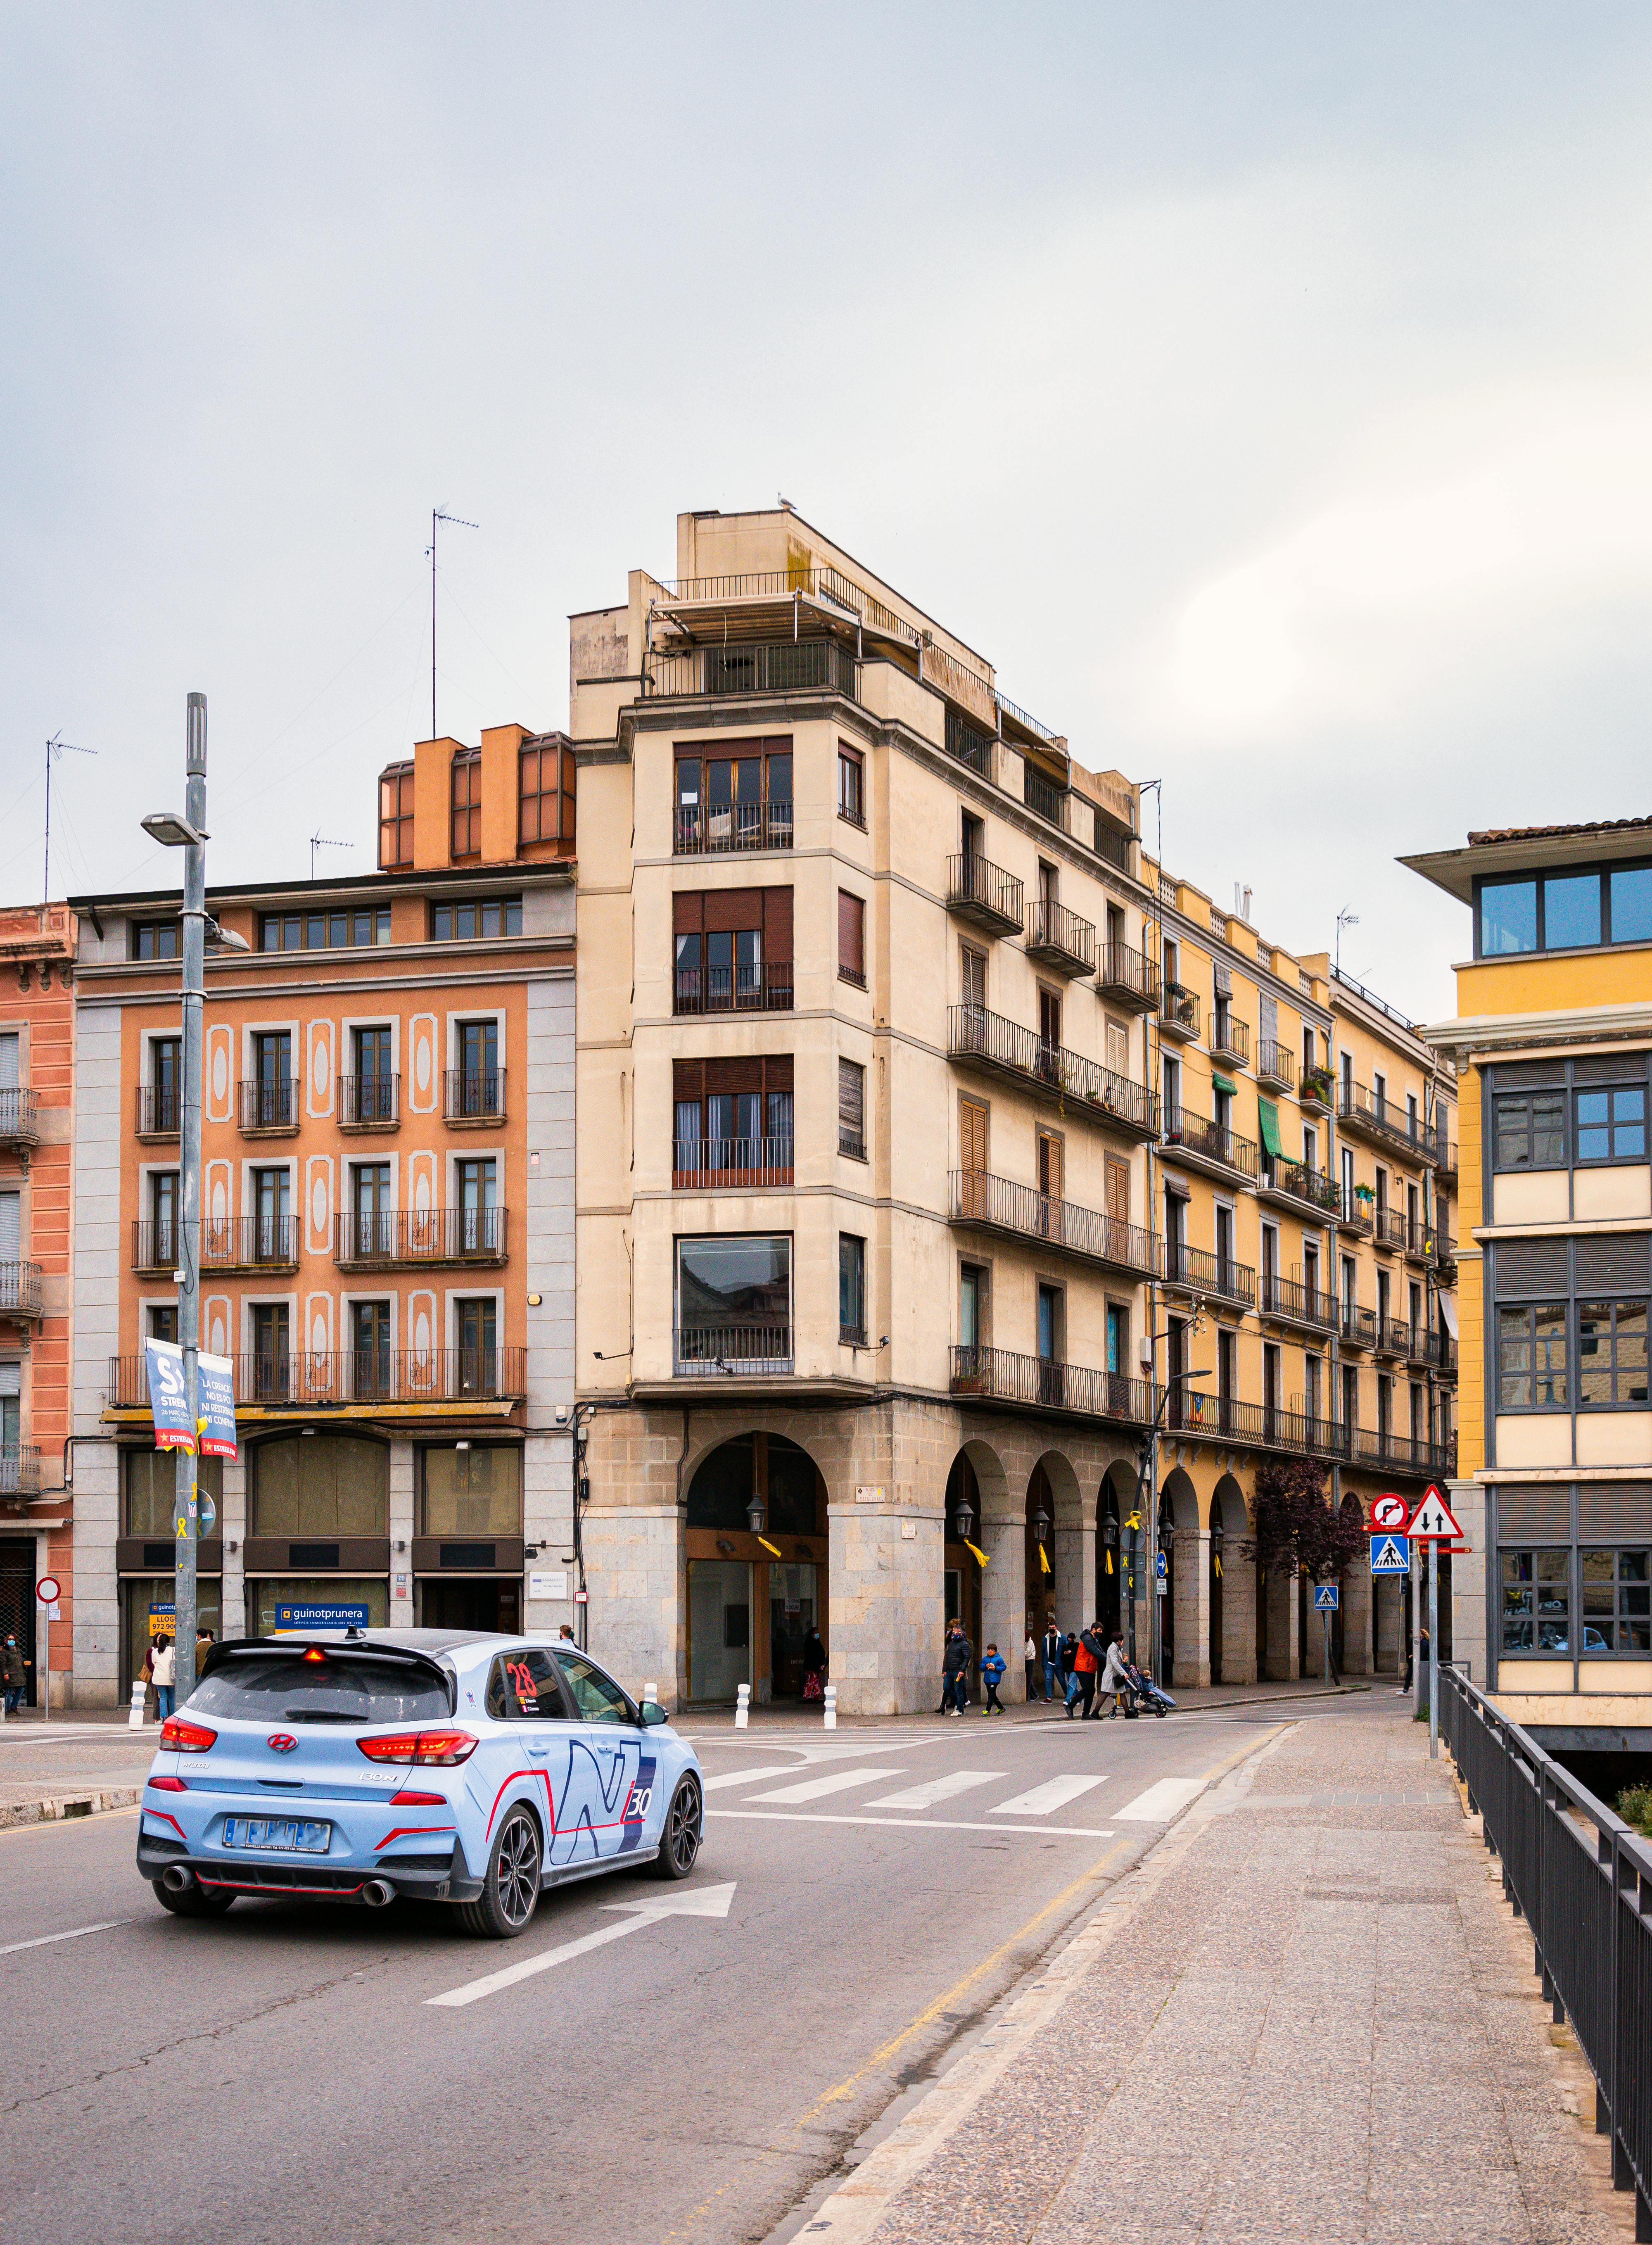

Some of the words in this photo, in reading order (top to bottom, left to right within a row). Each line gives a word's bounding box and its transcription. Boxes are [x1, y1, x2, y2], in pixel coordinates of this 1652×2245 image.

[202, 1379, 210, 1388] LA
[211, 1381, 231, 1394] CREACIÓ
[206, 1391, 216, 1400] NO
[217, 1394, 223, 1402] ES
[202, 1403, 209, 1411] NI
[204, 1415, 212, 1423] NI
[294, 1608, 362, 1620] guinotprunera
[507, 1663, 537, 1696] 28
[358, 1772, 382, 1781] i30
